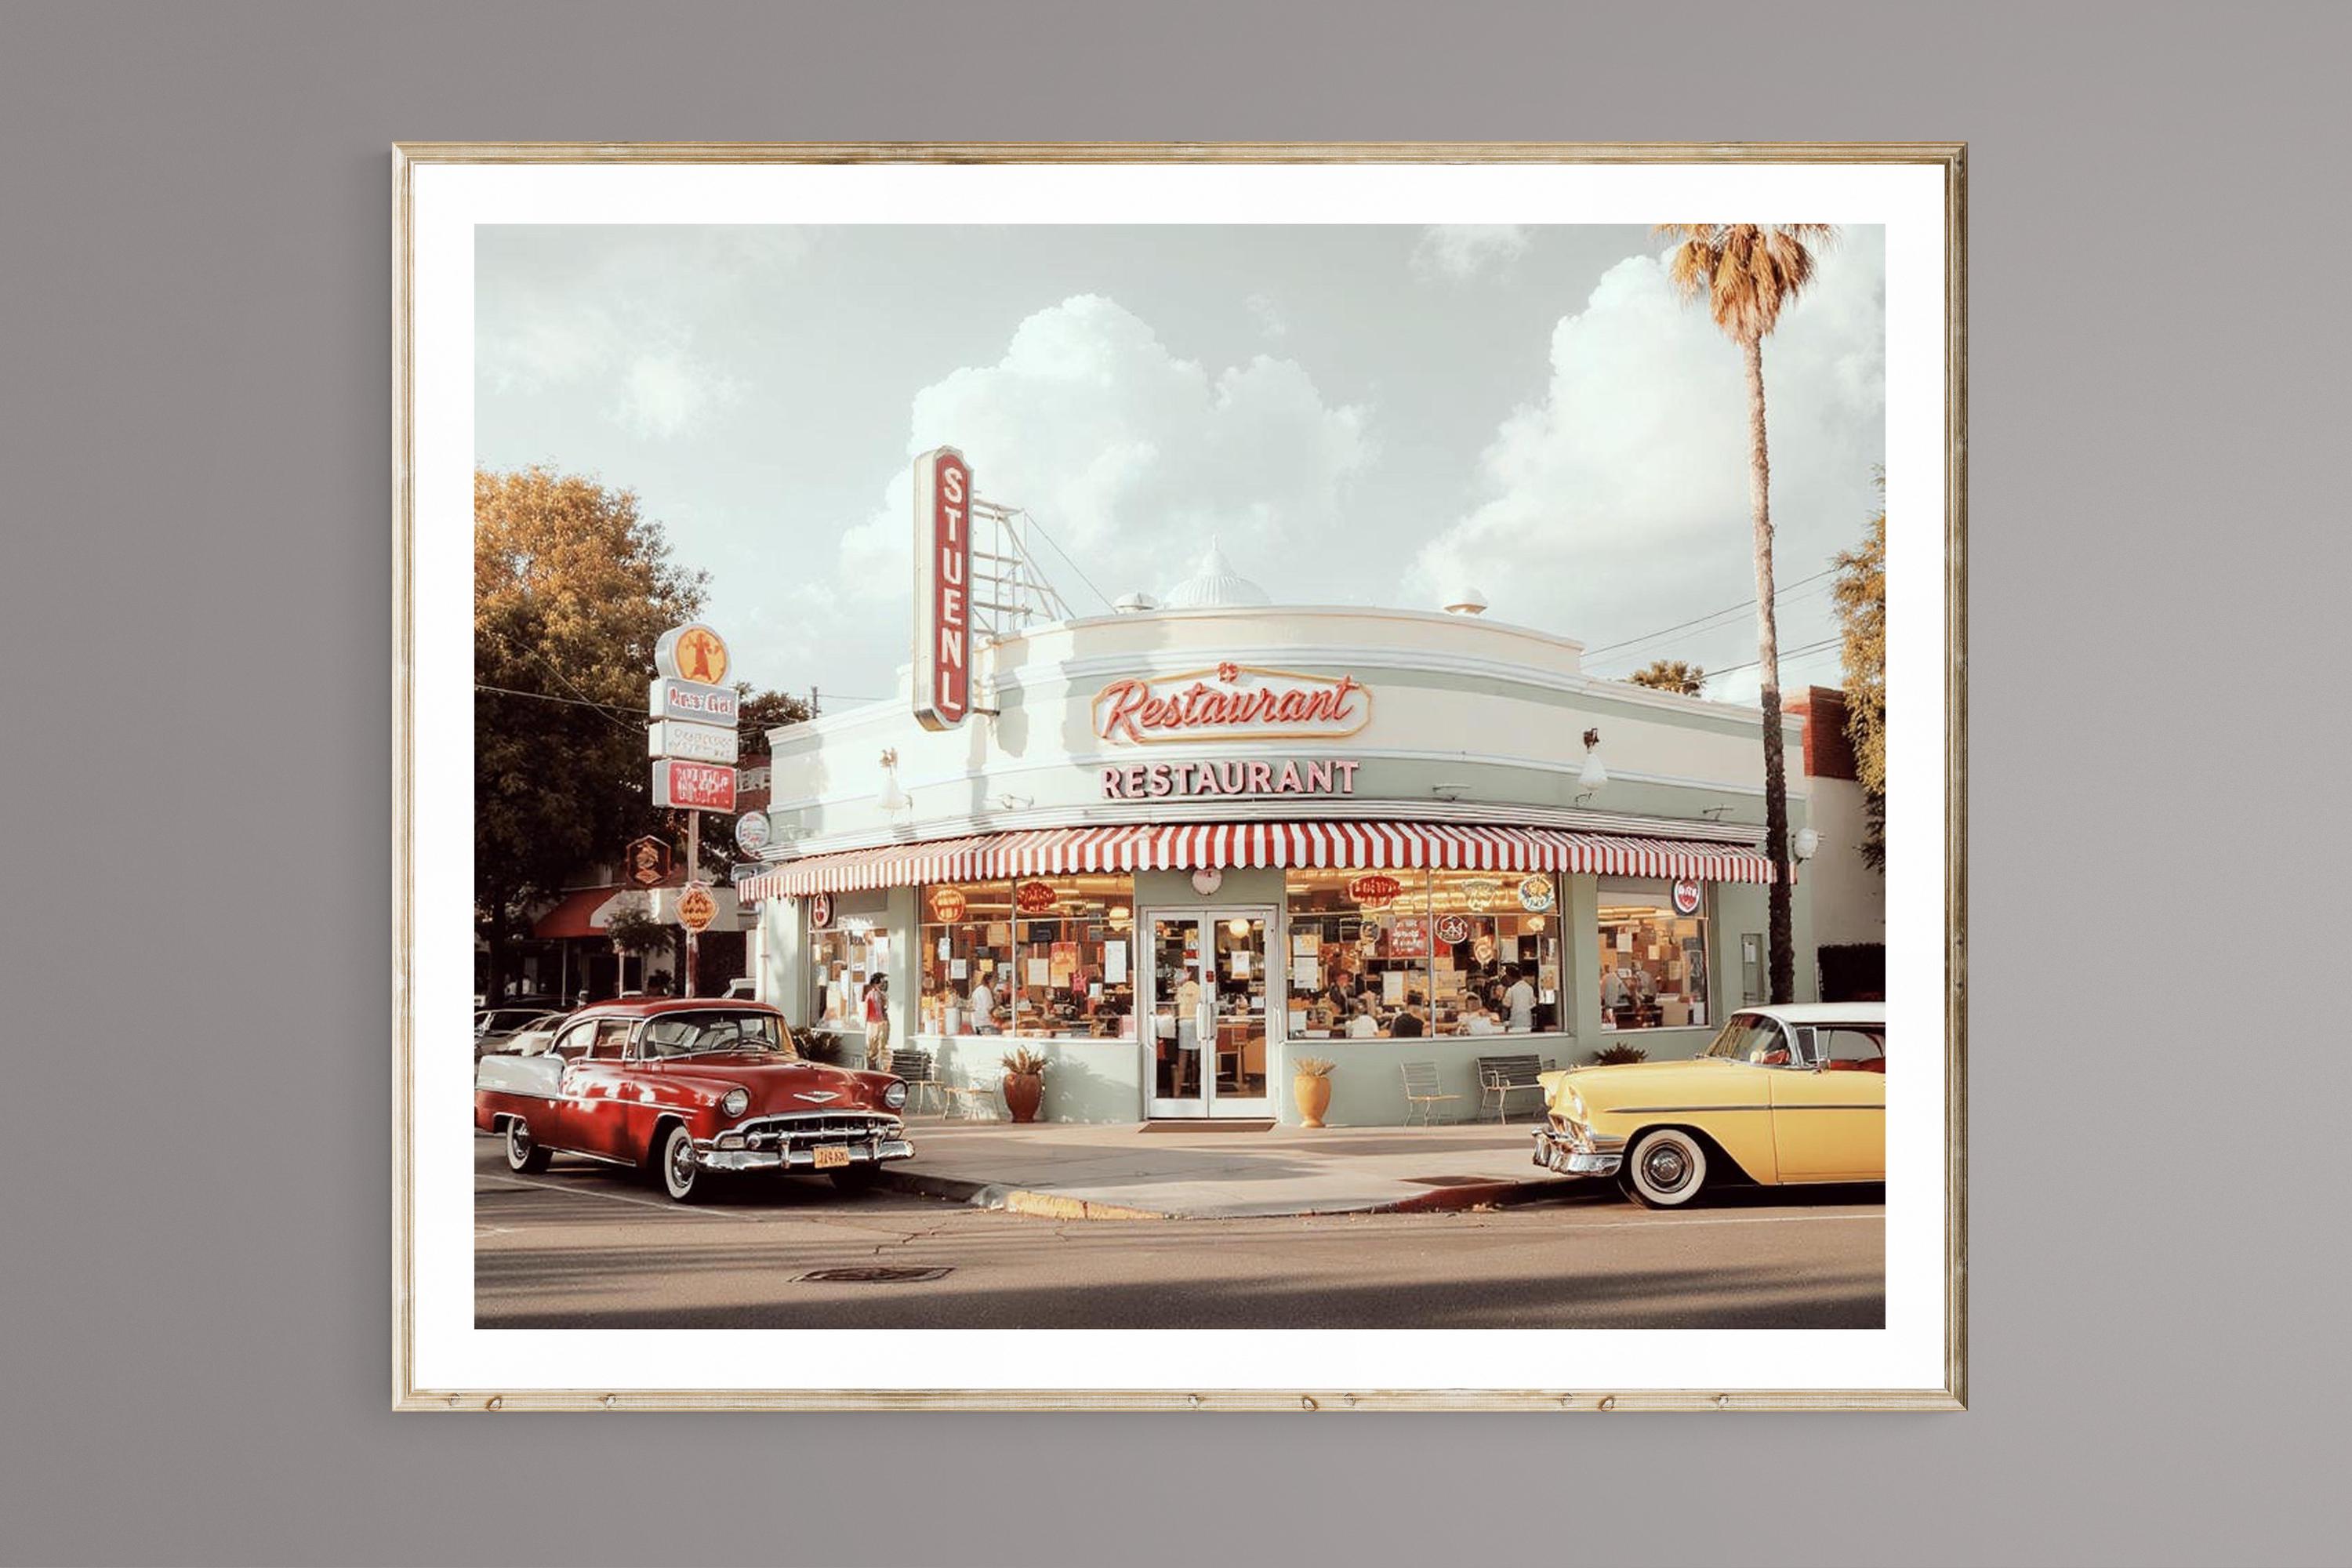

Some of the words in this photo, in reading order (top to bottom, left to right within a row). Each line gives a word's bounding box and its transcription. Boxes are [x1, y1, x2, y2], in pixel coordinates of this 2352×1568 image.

[941, 467, 963, 710] STUENL
[1101, 675, 1360, 744] Restaurant
[1101, 759, 1360, 798] RESTAURANT
